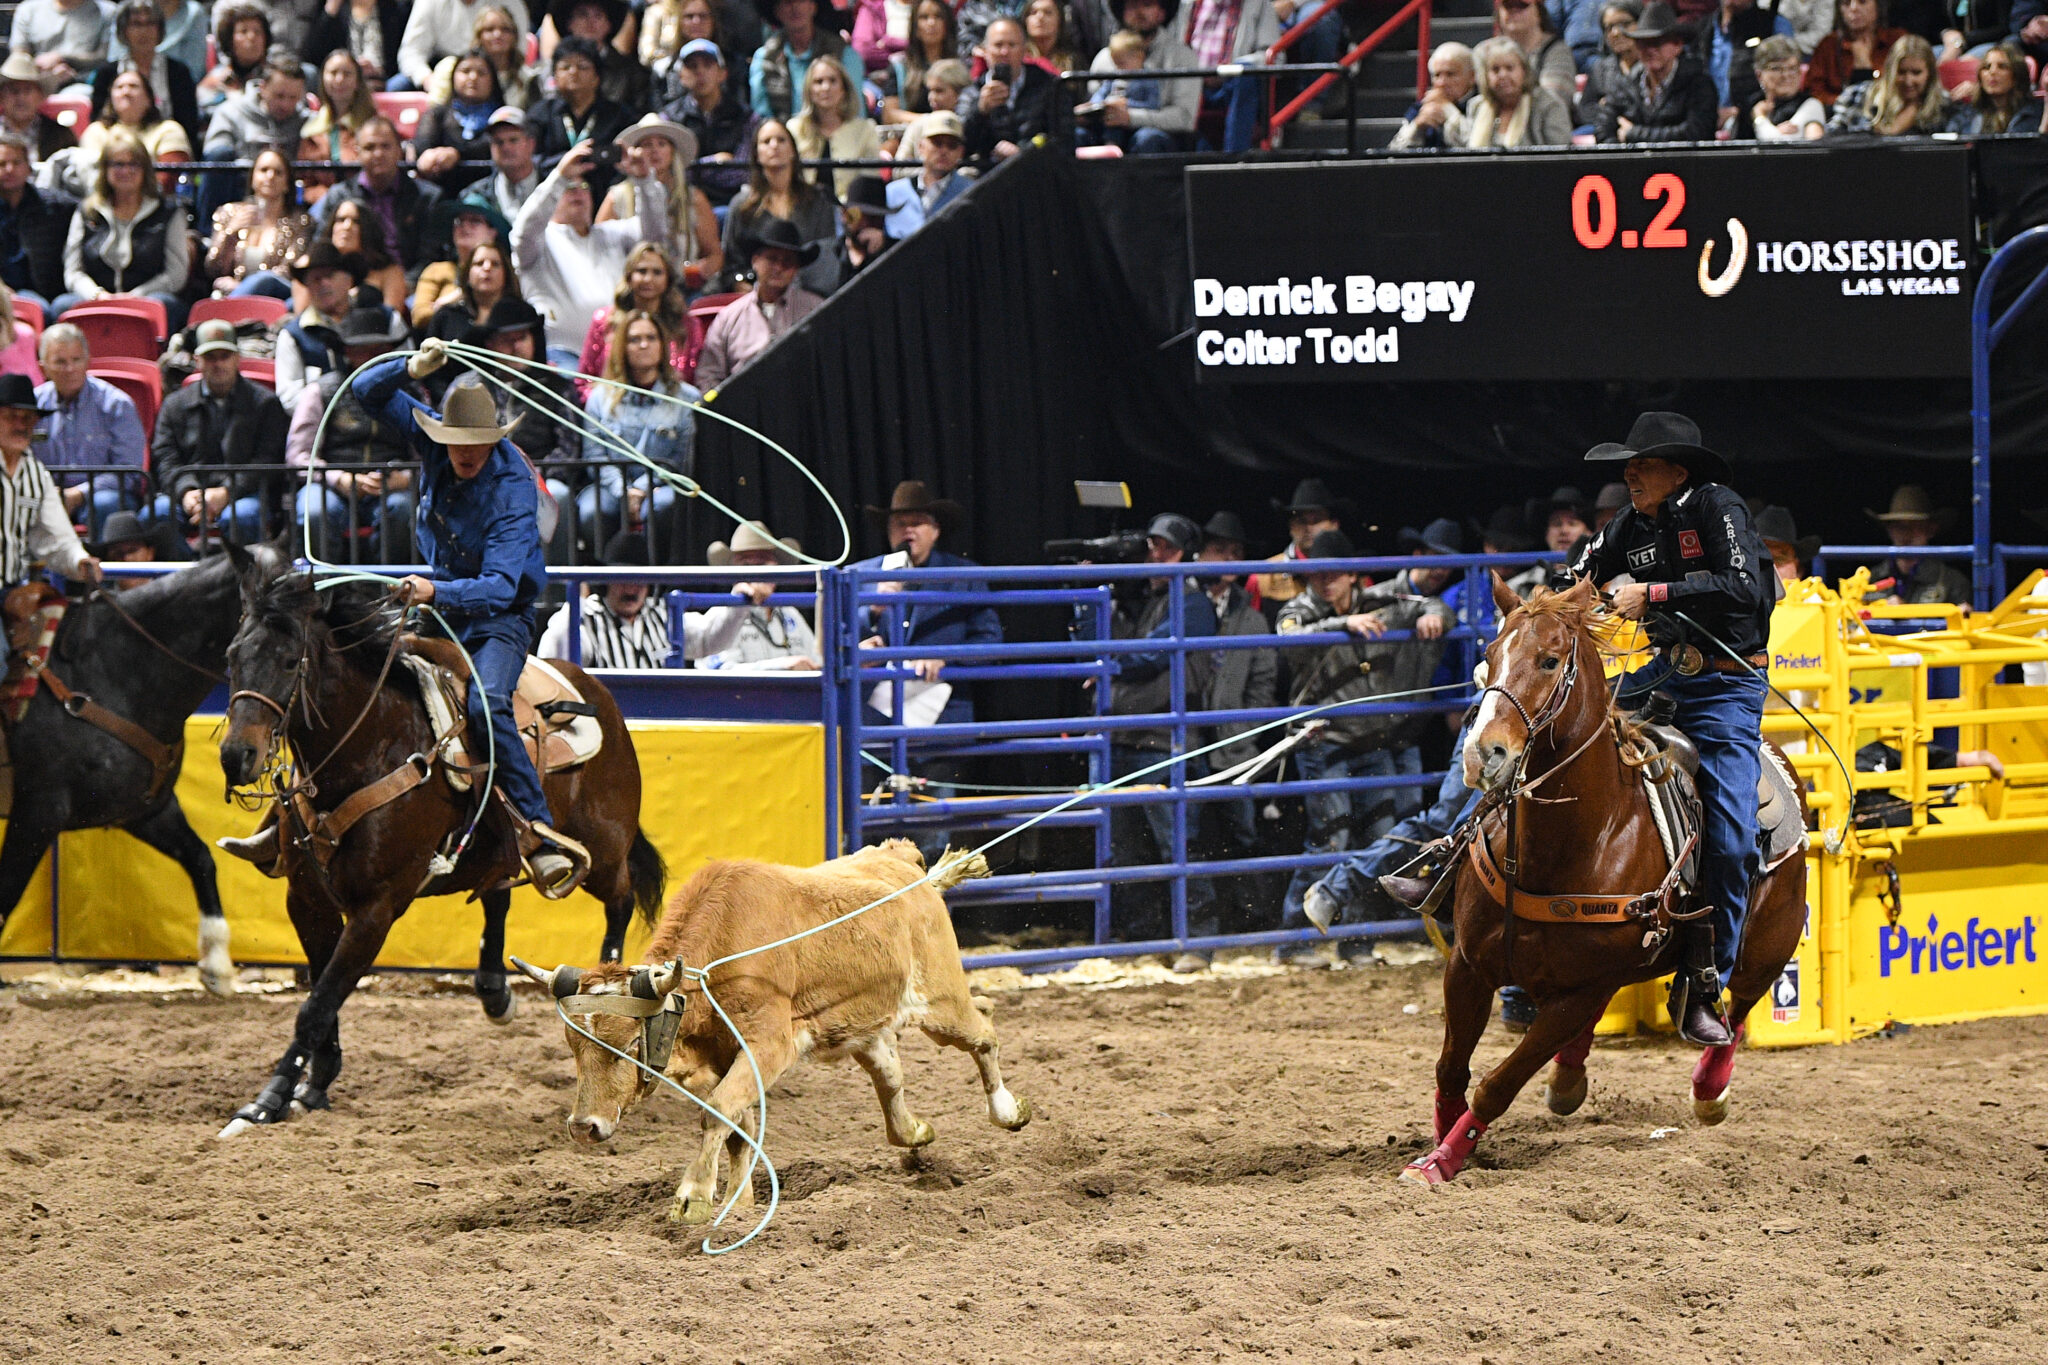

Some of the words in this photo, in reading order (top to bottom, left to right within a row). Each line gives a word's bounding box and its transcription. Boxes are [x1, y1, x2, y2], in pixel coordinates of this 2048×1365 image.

[1571, 173, 1688, 249] 0.2
[1194, 277, 1338, 317] Derrick
[1345, 275, 1475, 323] Begay
[1841, 278, 1874, 296] LAS
[1887, 277, 1960, 295] VEGAS
[1197, 328, 1302, 366] Colter
[1305, 326, 1399, 363] Todd
[1630, 547, 1656, 567] YET
[1775, 652, 1821, 669] Priefert
[1581, 902, 1618, 916] QUANTA
[1879, 912, 2036, 977] Priefert
